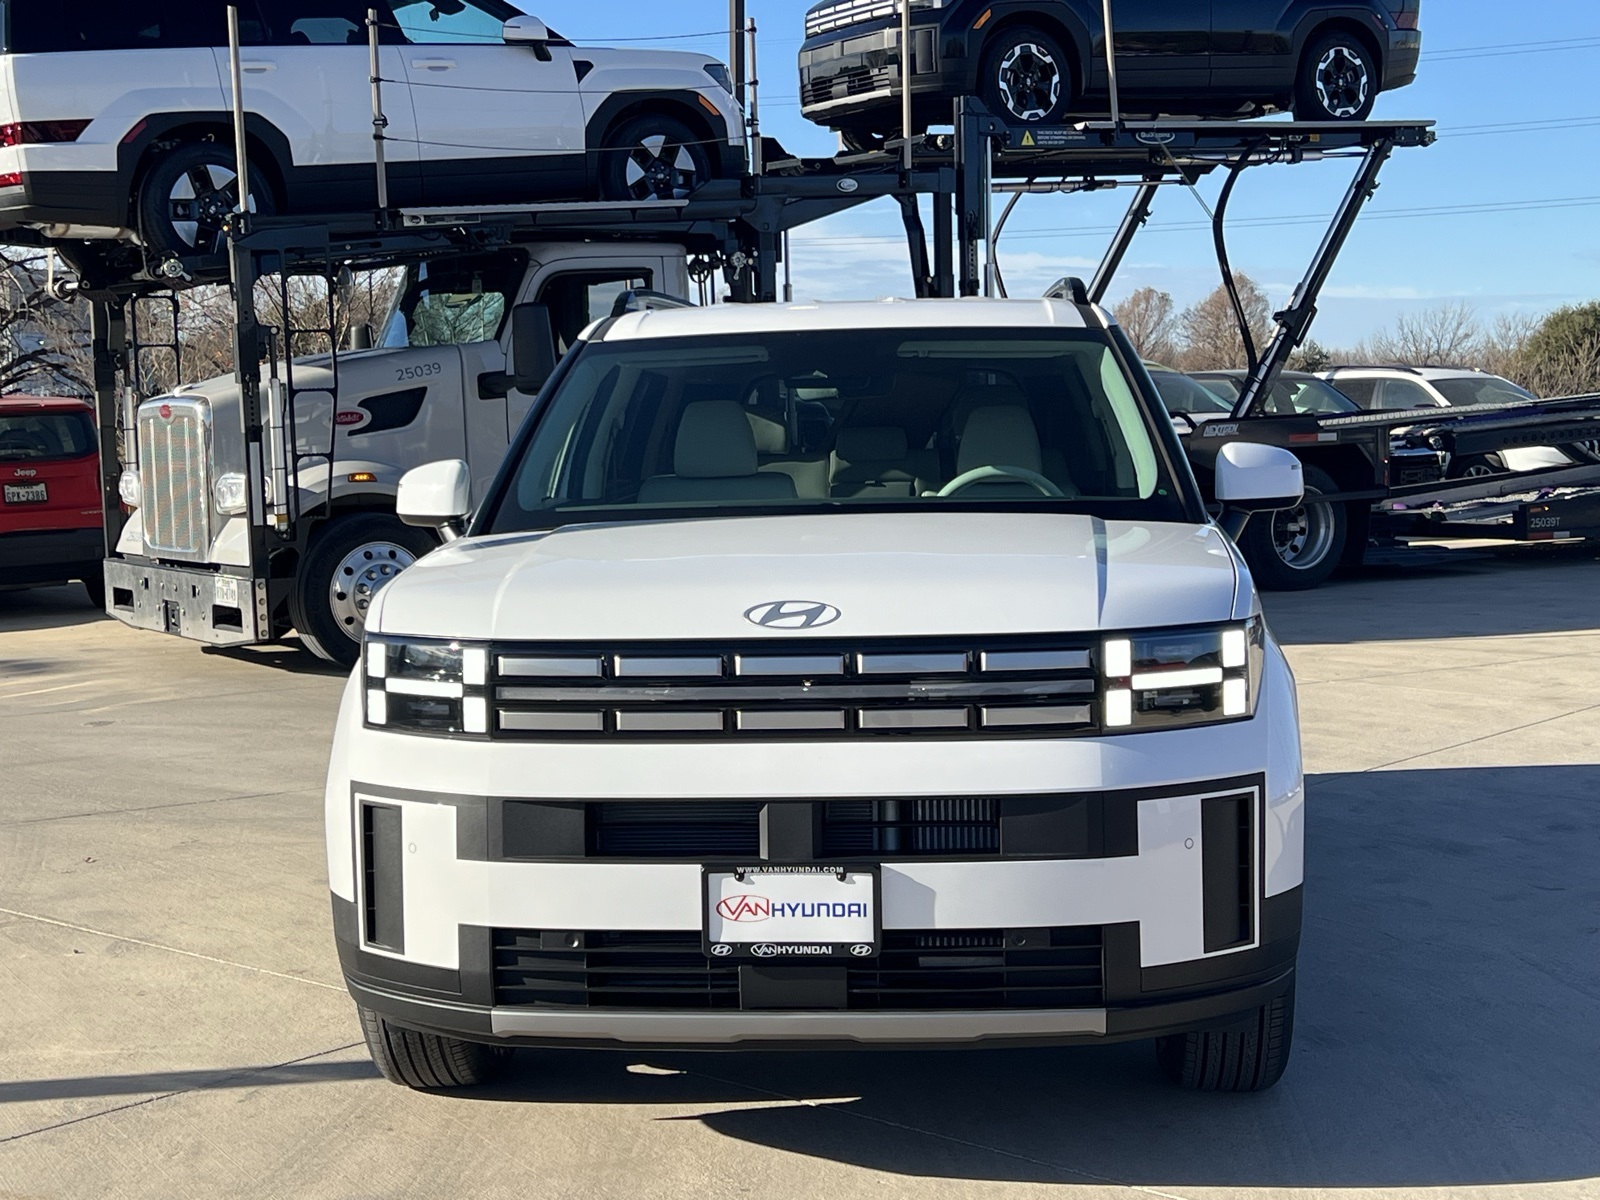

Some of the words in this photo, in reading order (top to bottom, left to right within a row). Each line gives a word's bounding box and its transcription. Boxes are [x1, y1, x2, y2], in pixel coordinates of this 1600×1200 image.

[395, 362, 442, 381] 25039
[14, 468, 37, 477] Jeep
[1530, 517, 1561, 528] 25039T
[736, 866, 844, 874] WWW.VANHYUNDAI.COM
